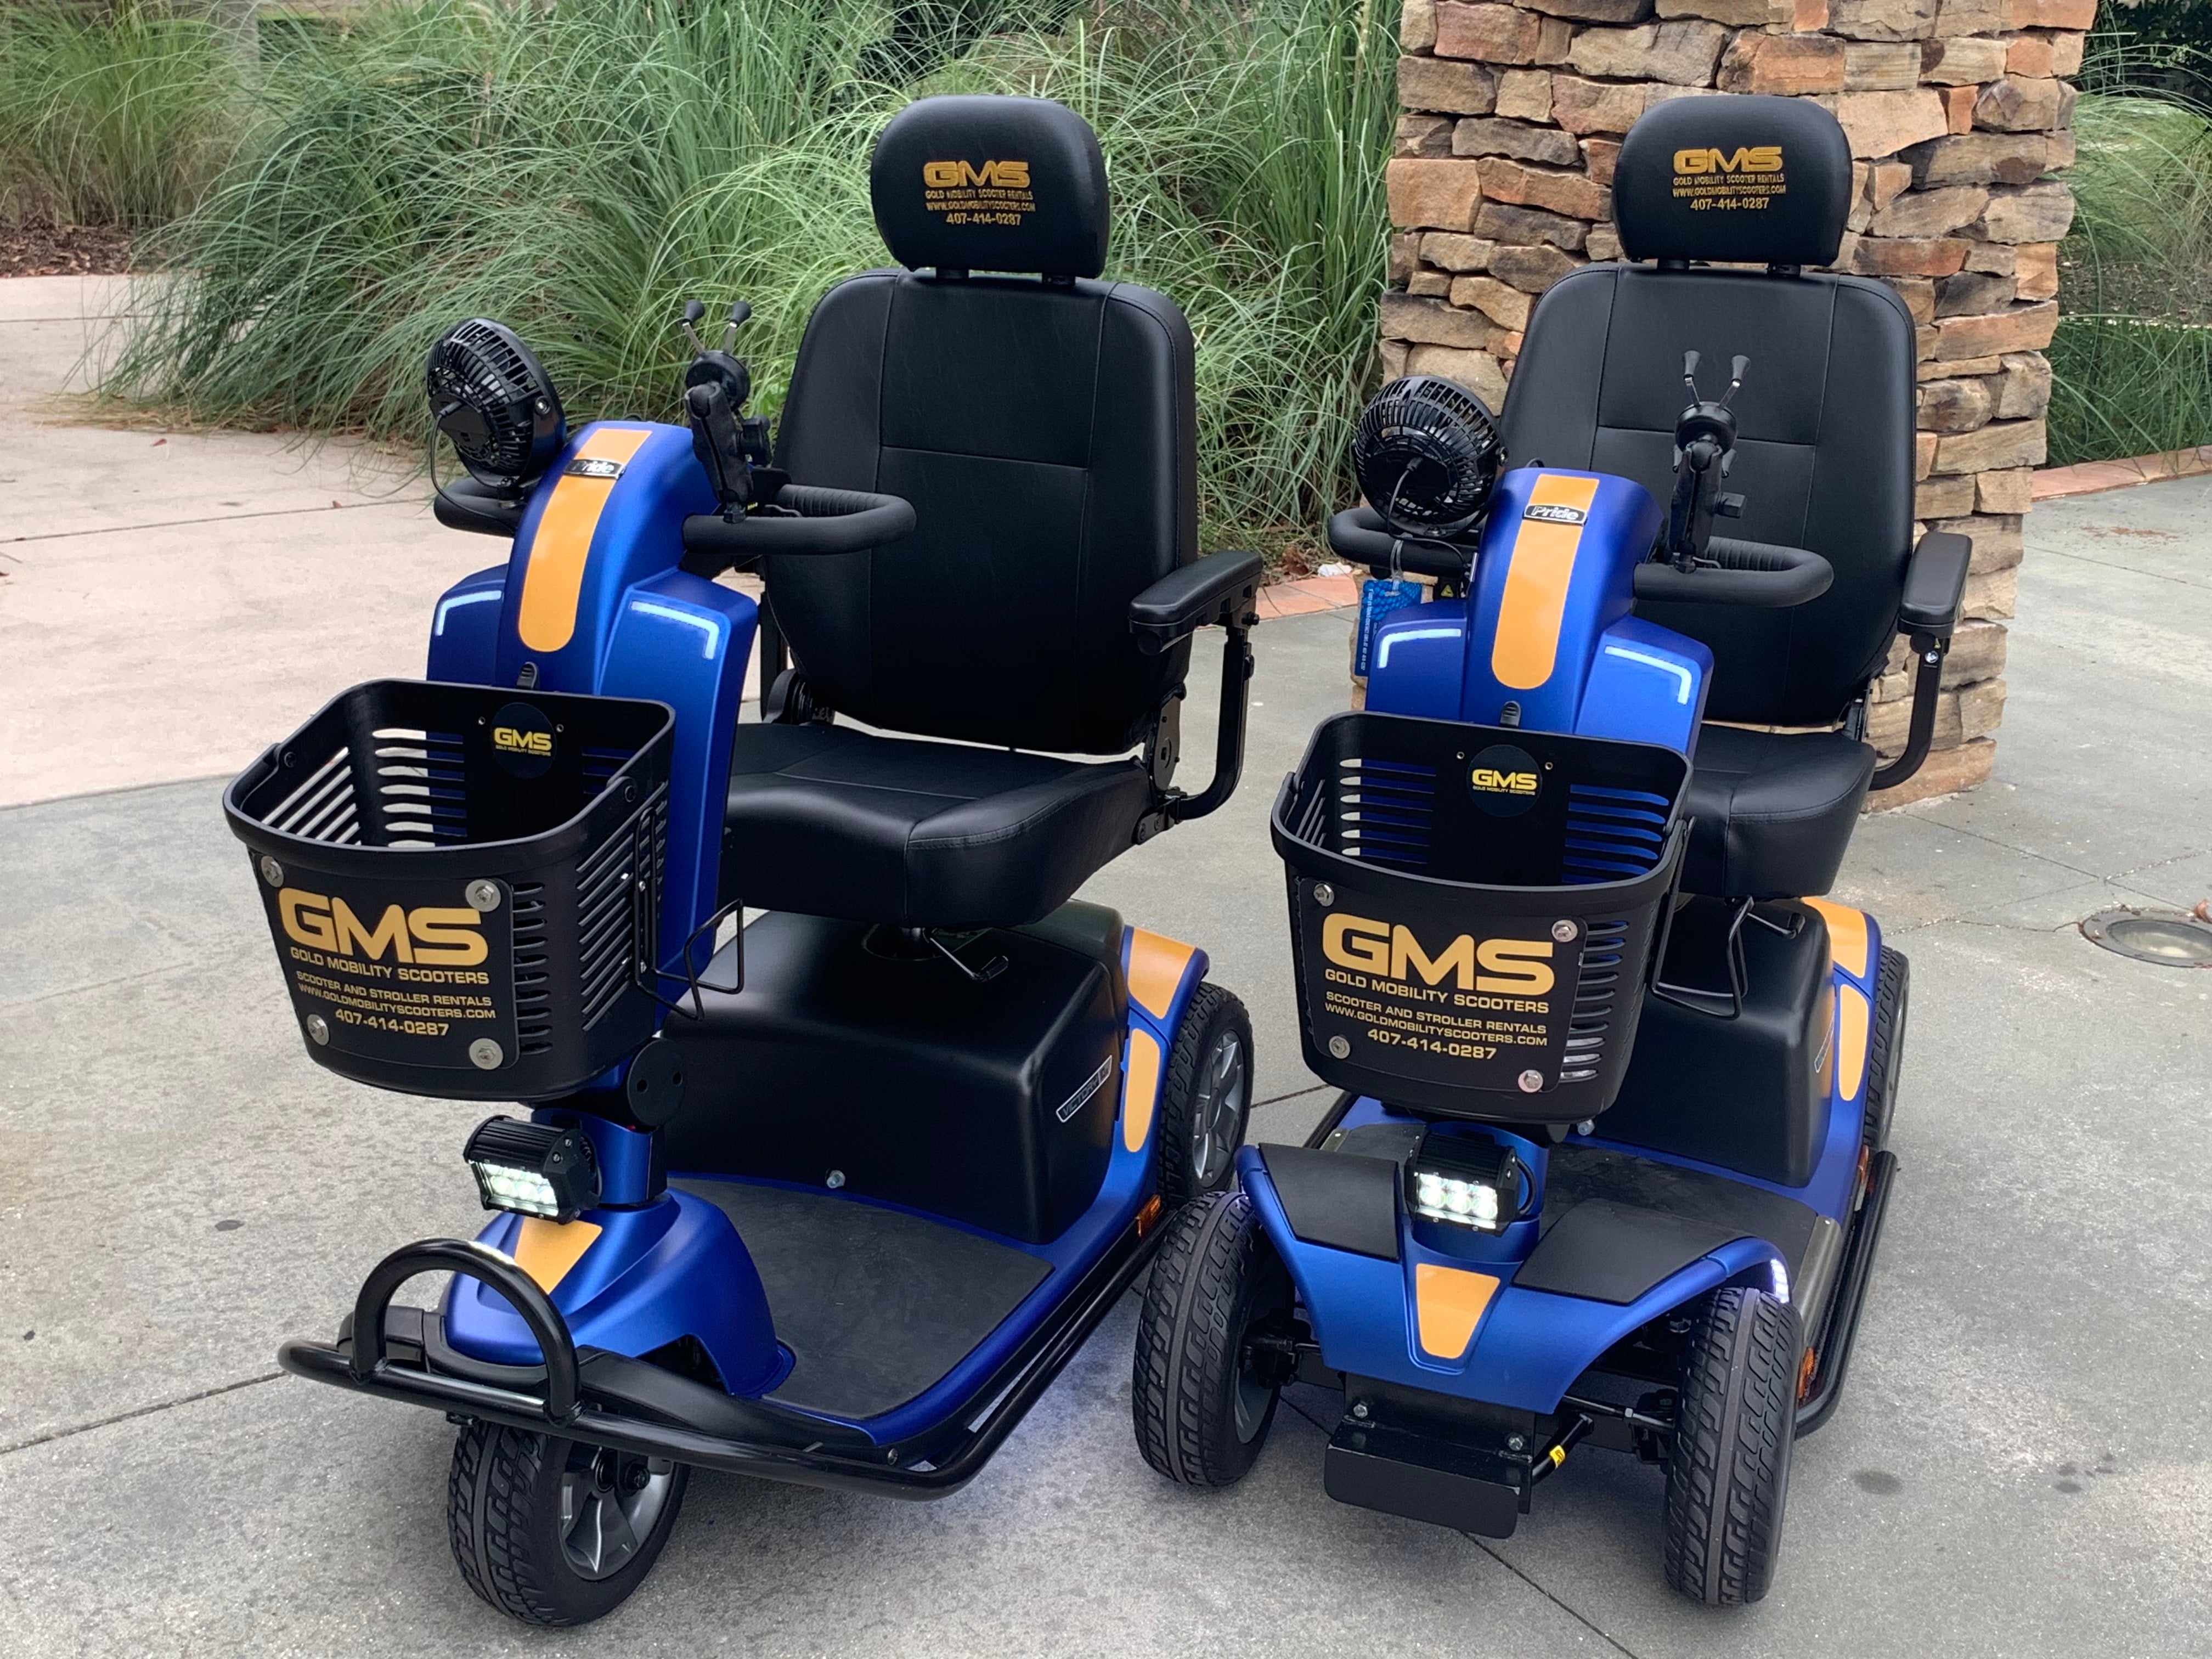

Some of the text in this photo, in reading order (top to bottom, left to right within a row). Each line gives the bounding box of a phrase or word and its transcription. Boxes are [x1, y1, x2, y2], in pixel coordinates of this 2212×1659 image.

[924, 160, 1030, 188] GMS
[1674, 146, 1782, 174] GMS
[1673, 173, 1784, 185] GOLD MOBILITY SCOOTER RENTALS
[926, 190, 944, 199] GOLD
[946, 189, 975, 199] MOBILITY
[979, 189, 1006, 199] SCOOTER
[1690, 198, 1769, 210] 407-414-0287
[946, 212, 1022, 225] 407-414-0287
[1531, 506, 1579, 520] Pride
[494, 727, 552, 751] GMS
[1472, 769, 1537, 790] GMS
[278, 887, 488, 966] GMS
[290, 946, 489, 985] GOLD MOBILITY SCOOTERS
[1322, 913, 1555, 995] GMS
[296, 970, 492, 1006] SCOOTER AND STROLLER RENTALS
[298, 983, 495, 1018] WWW.GOLDMOBILITYSCOOTERS.COM
[1325, 968, 1549, 1013] GOLD MOBILITY SCOOTERS
[335, 1009, 449, 1036] 407-414-0287
[1325, 1002, 1548, 1046] WWW.GOLDMOBILITYSCOOTERS.COM
[1326, 991, 1546, 1034] SCOOTER AND STROLLER RENTALS
[1367, 1029, 1497, 1059] 407-414-0287
[1062, 1075, 1099, 1116] VICTORY
